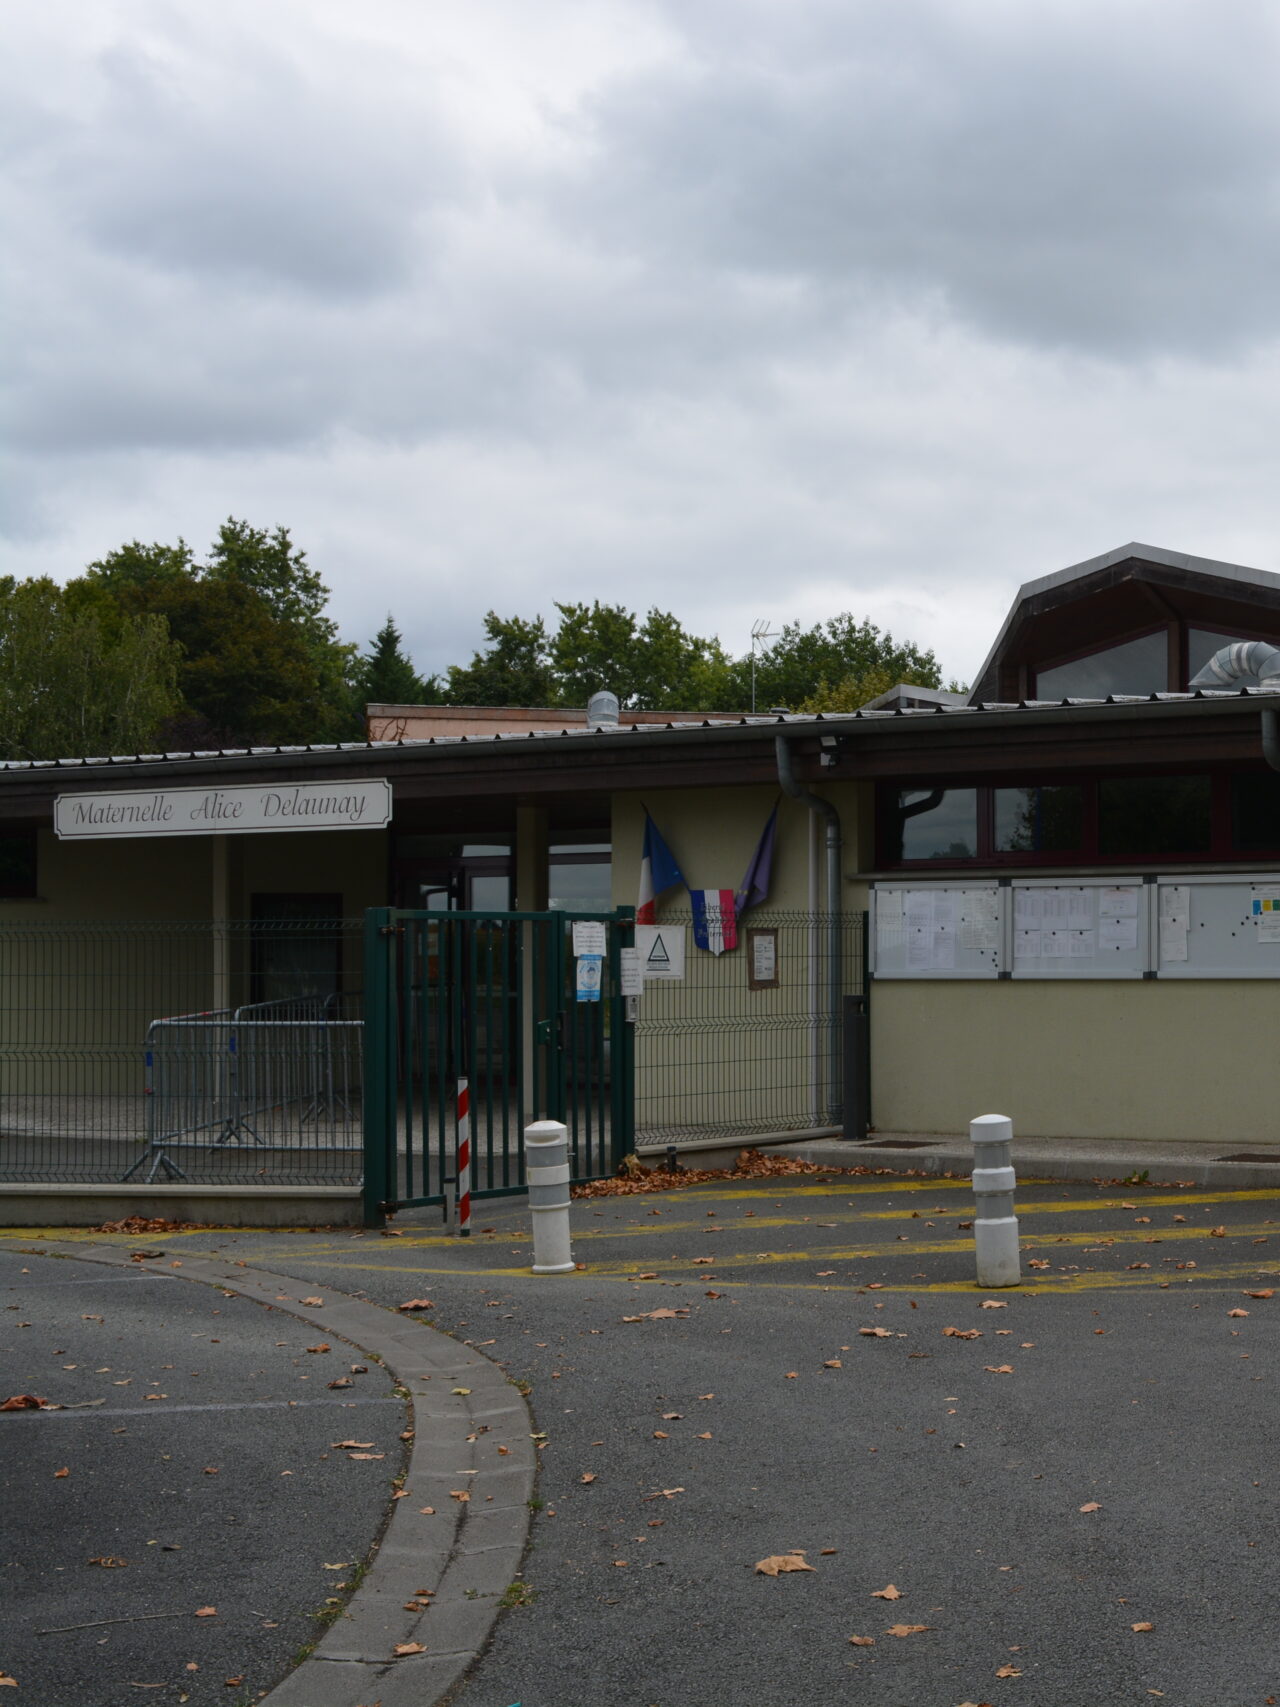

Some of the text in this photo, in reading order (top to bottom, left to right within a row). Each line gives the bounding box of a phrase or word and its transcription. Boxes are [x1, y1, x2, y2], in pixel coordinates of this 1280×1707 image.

[71, 788, 367, 825] Maternelle Alice Delaunay
